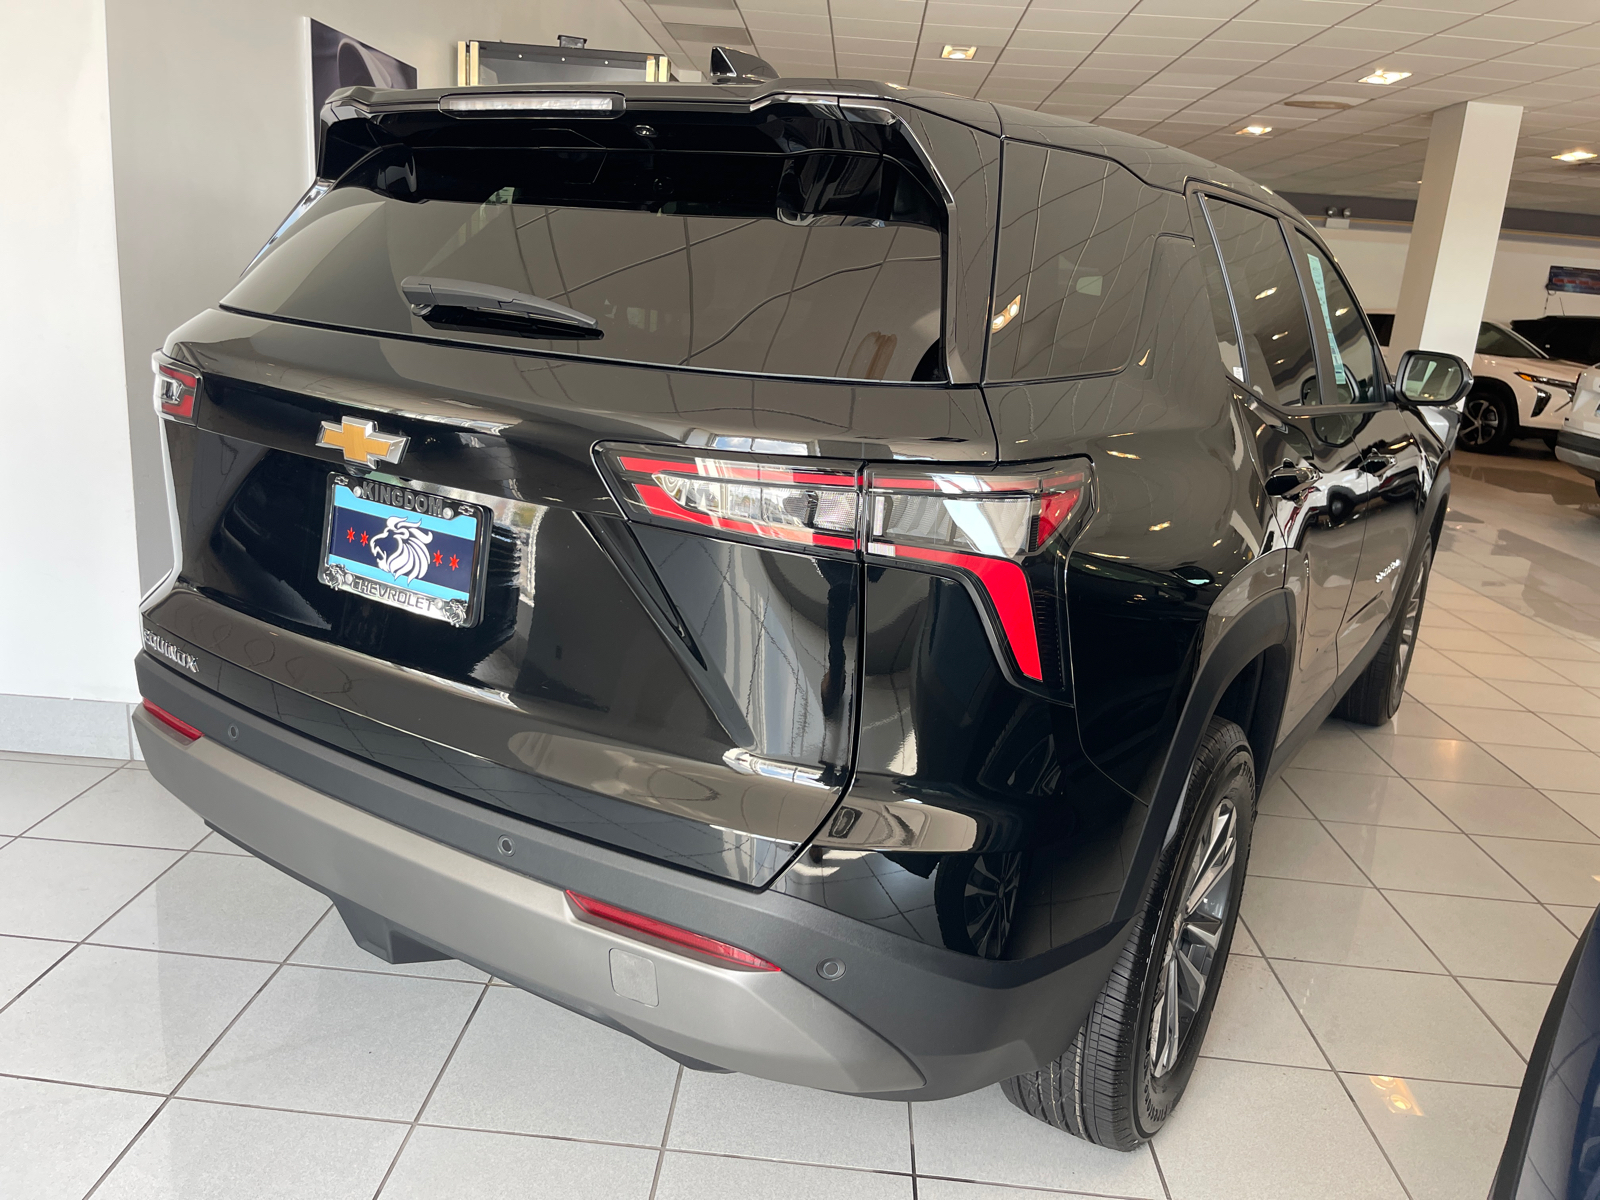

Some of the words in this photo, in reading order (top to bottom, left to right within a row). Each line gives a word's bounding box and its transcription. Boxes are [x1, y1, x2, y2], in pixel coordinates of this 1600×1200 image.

[362, 481, 443, 518] KINGDOM
[351, 578, 435, 612] CHEVROLET
[144, 628, 199, 673] EQUINOX
